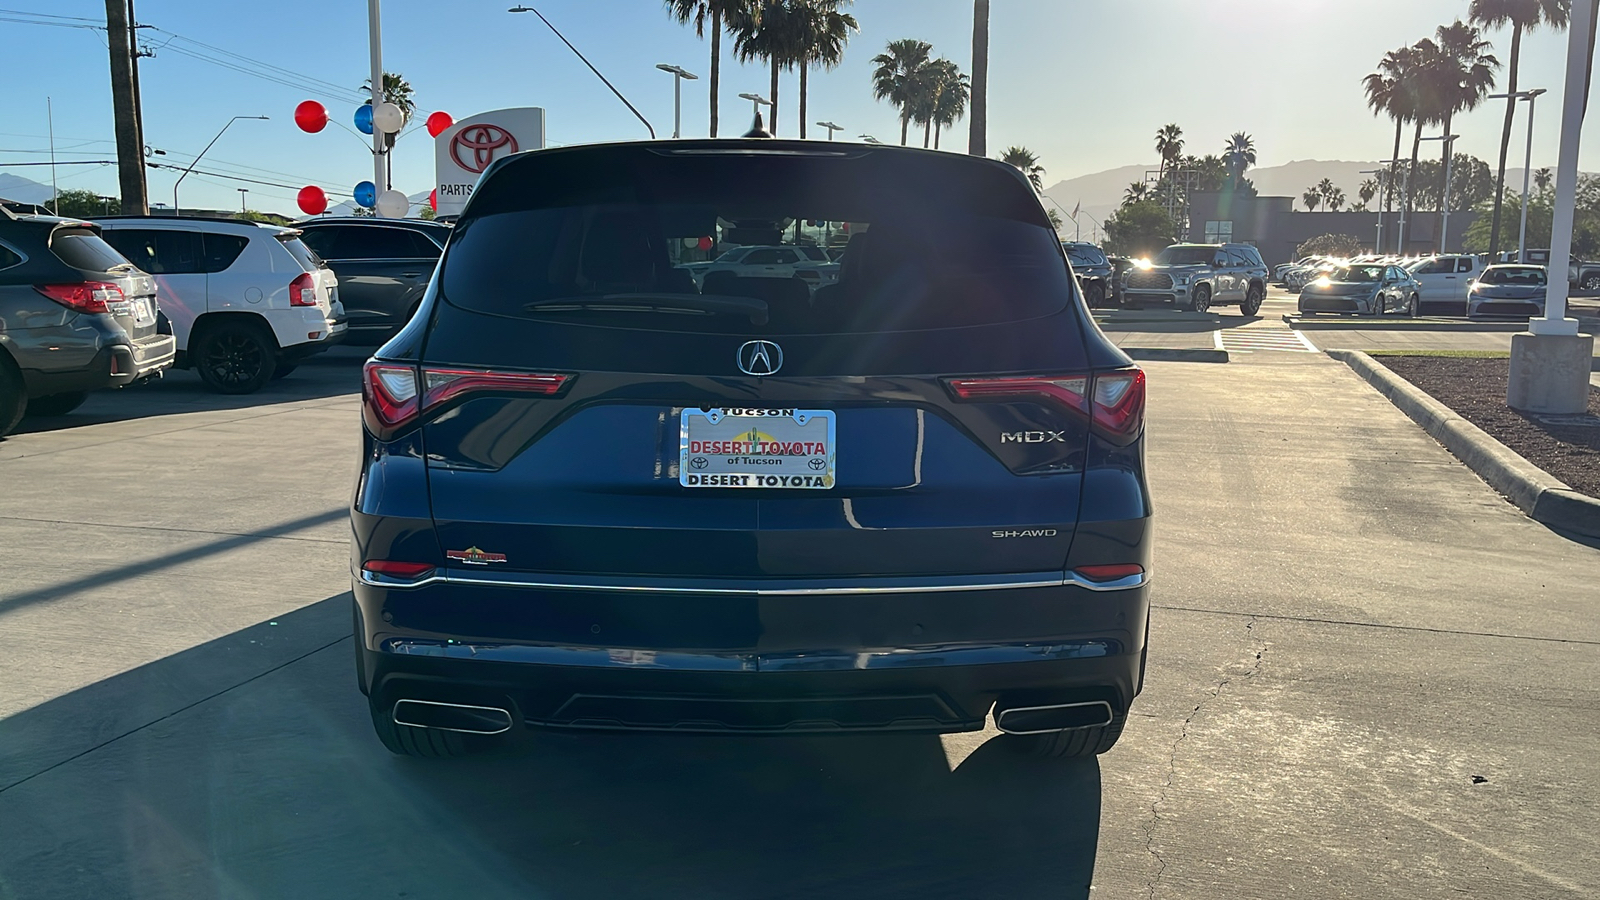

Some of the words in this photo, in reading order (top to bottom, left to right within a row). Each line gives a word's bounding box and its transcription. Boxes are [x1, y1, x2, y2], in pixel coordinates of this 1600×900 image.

[440, 184, 474, 196] PARTS
[721, 408, 794, 416] TUCSON
[1001, 430, 1066, 443] MDX
[691, 441, 753, 454] DESERT
[759, 442, 825, 455] TOYOTA
[727, 457, 739, 465] of
[742, 457, 782, 465] Tucson
[688, 475, 749, 486] DESERT
[756, 476, 825, 487] TOYOTA
